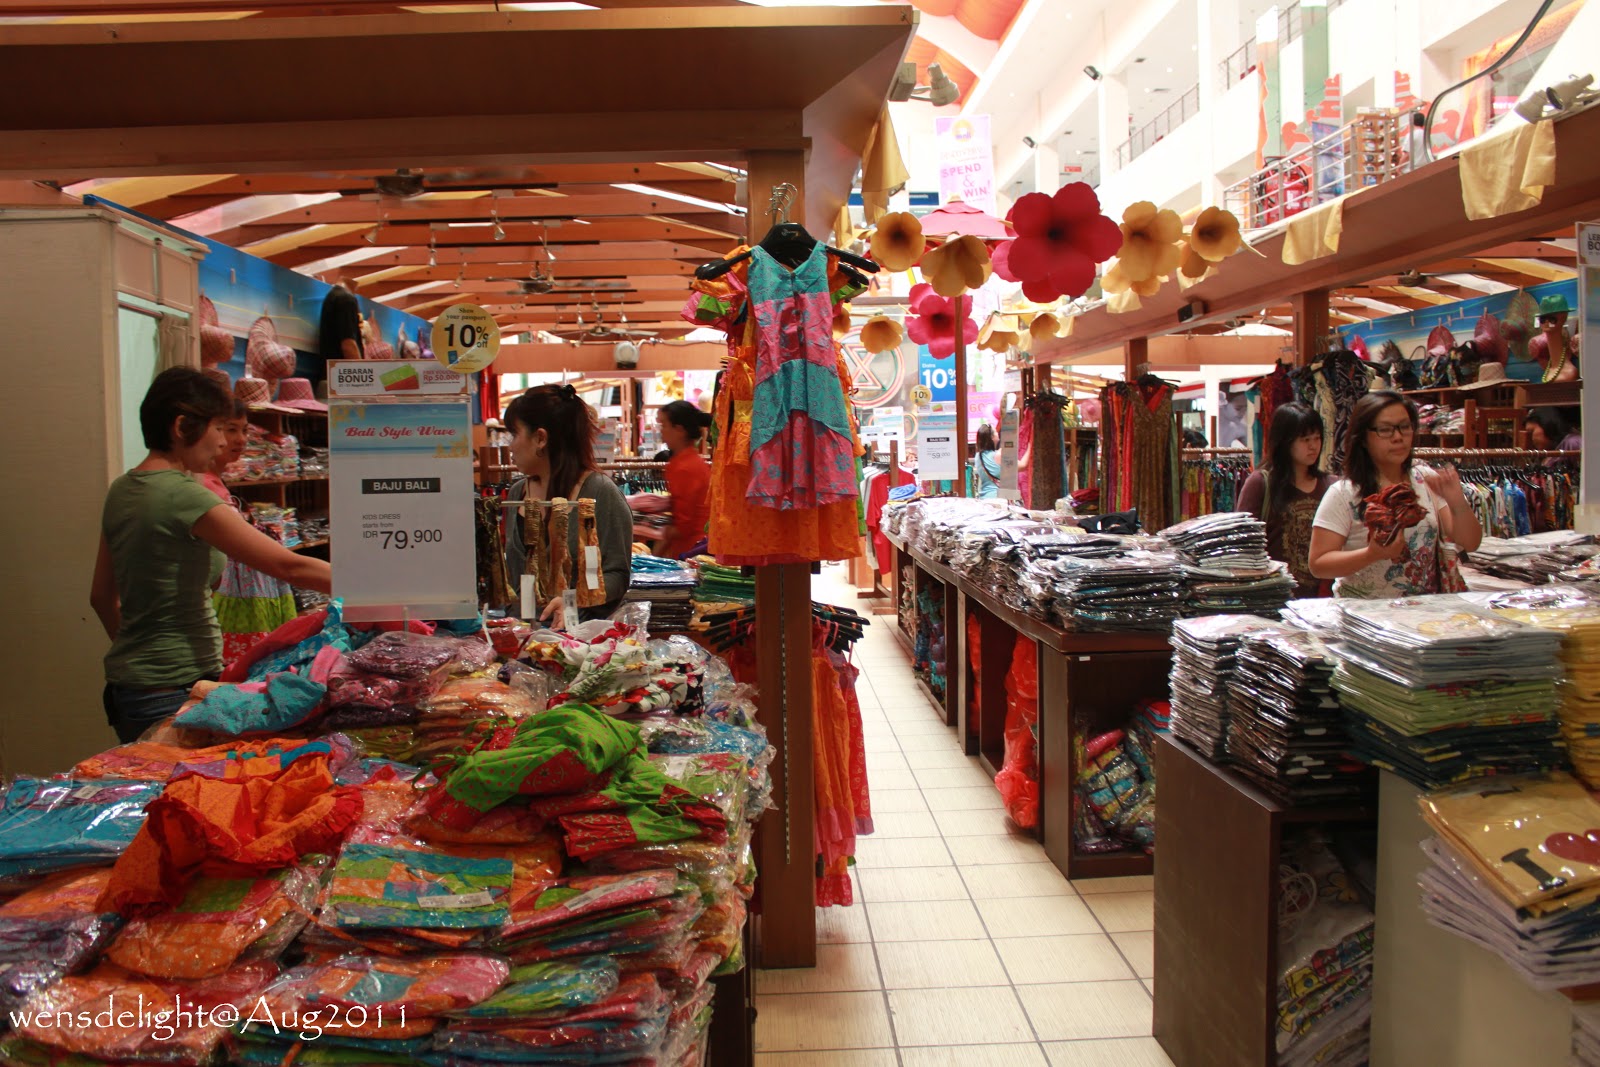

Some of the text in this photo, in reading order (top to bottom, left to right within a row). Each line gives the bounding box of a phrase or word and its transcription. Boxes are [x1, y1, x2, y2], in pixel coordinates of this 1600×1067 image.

[941, 163, 982, 178] SPEND
[338, 374, 374, 383] BONUS
[423, 374, 434, 383] Rp
[344, 425, 456, 440] Bali Style Wave
[373, 481, 430, 491] BAJU BALI
[363, 531, 379, 539] IDR
